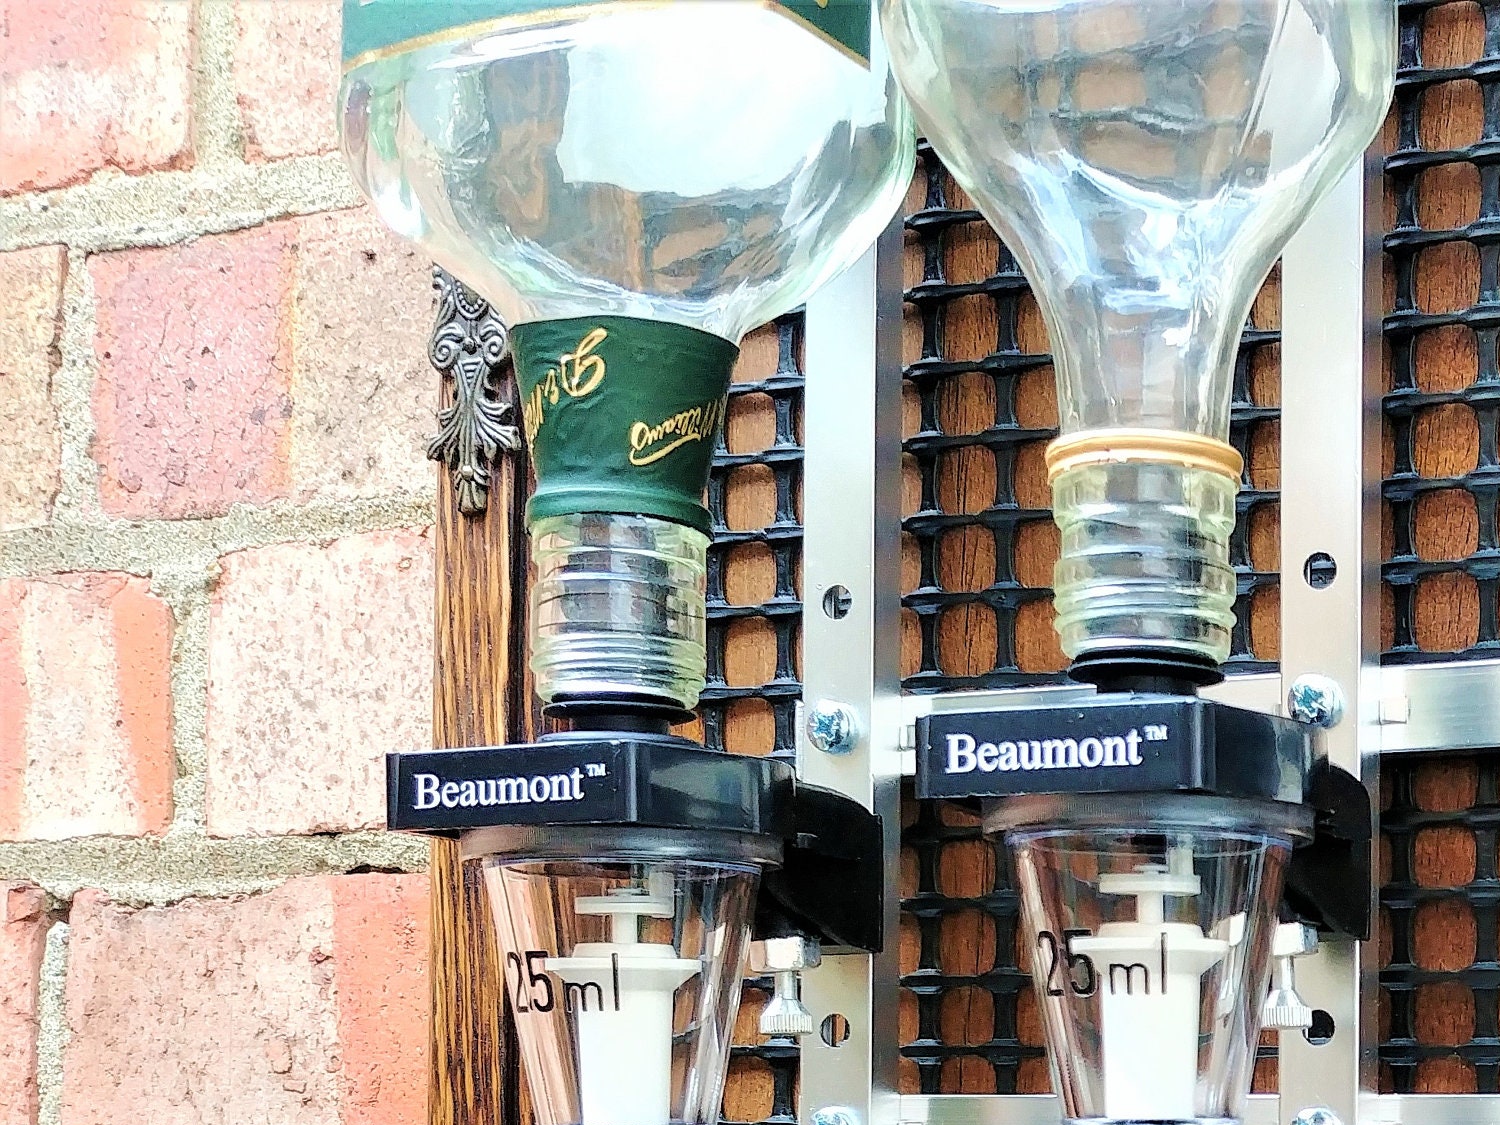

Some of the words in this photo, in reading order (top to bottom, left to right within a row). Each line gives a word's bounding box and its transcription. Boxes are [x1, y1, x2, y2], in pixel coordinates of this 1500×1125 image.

[507, 950, 552, 1014] 25
[563, 953, 620, 1013] ml
[1037, 928, 1099, 998] 25
[1108, 932, 1169, 996] ml
